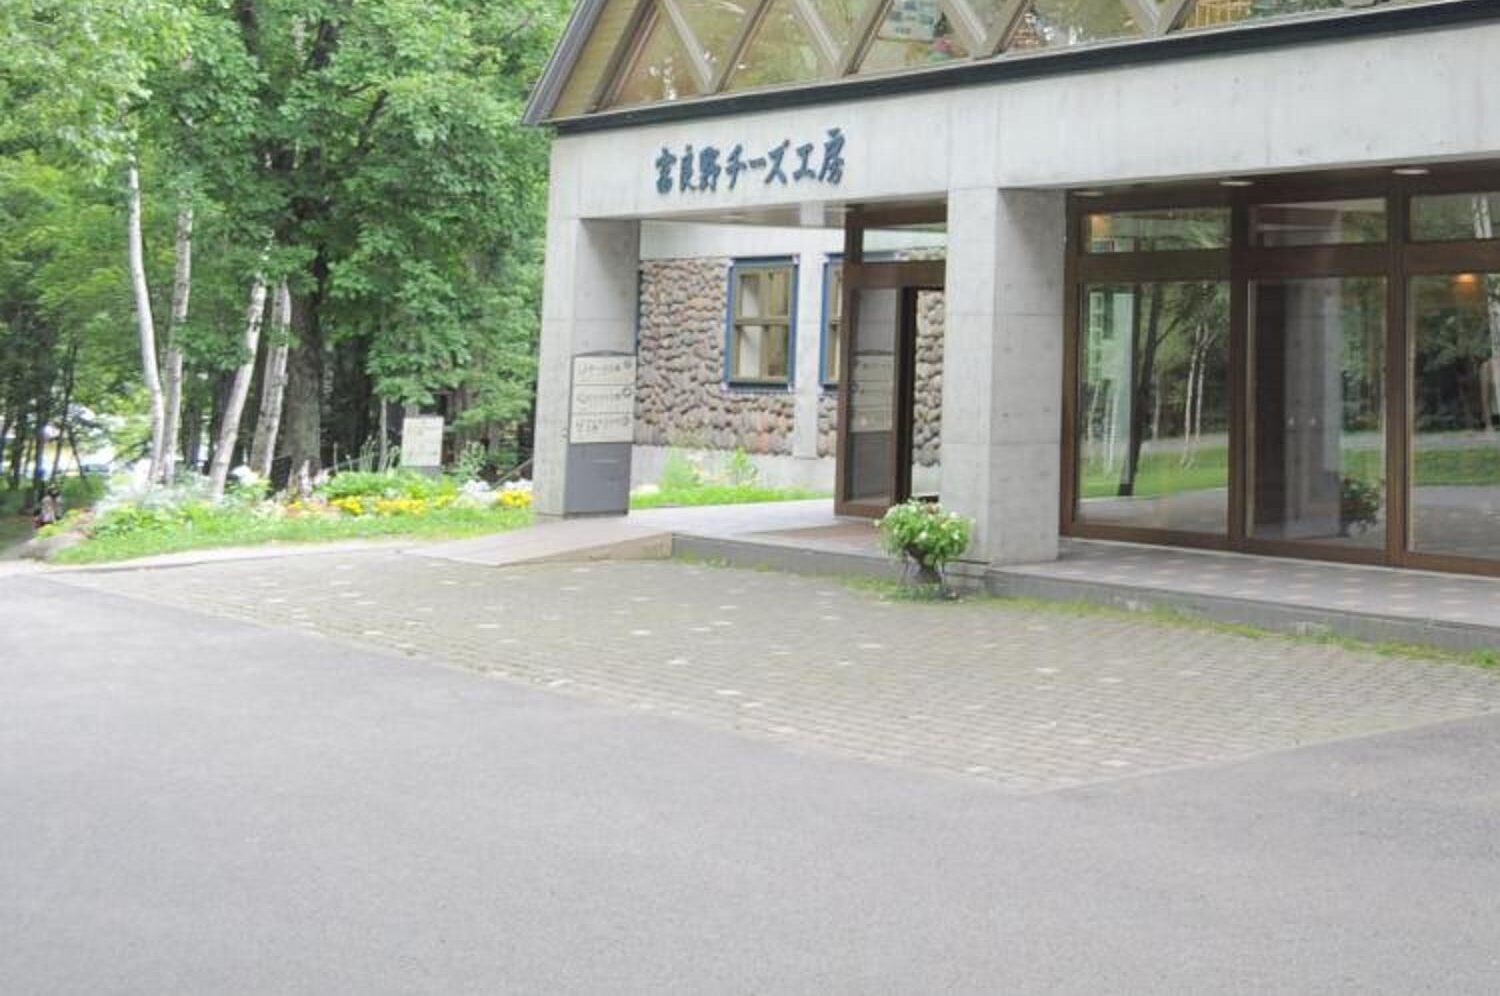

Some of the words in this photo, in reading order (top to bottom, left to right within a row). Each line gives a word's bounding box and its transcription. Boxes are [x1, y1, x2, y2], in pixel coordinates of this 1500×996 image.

[655, 127, 846, 194] 富良野チーズ工房
